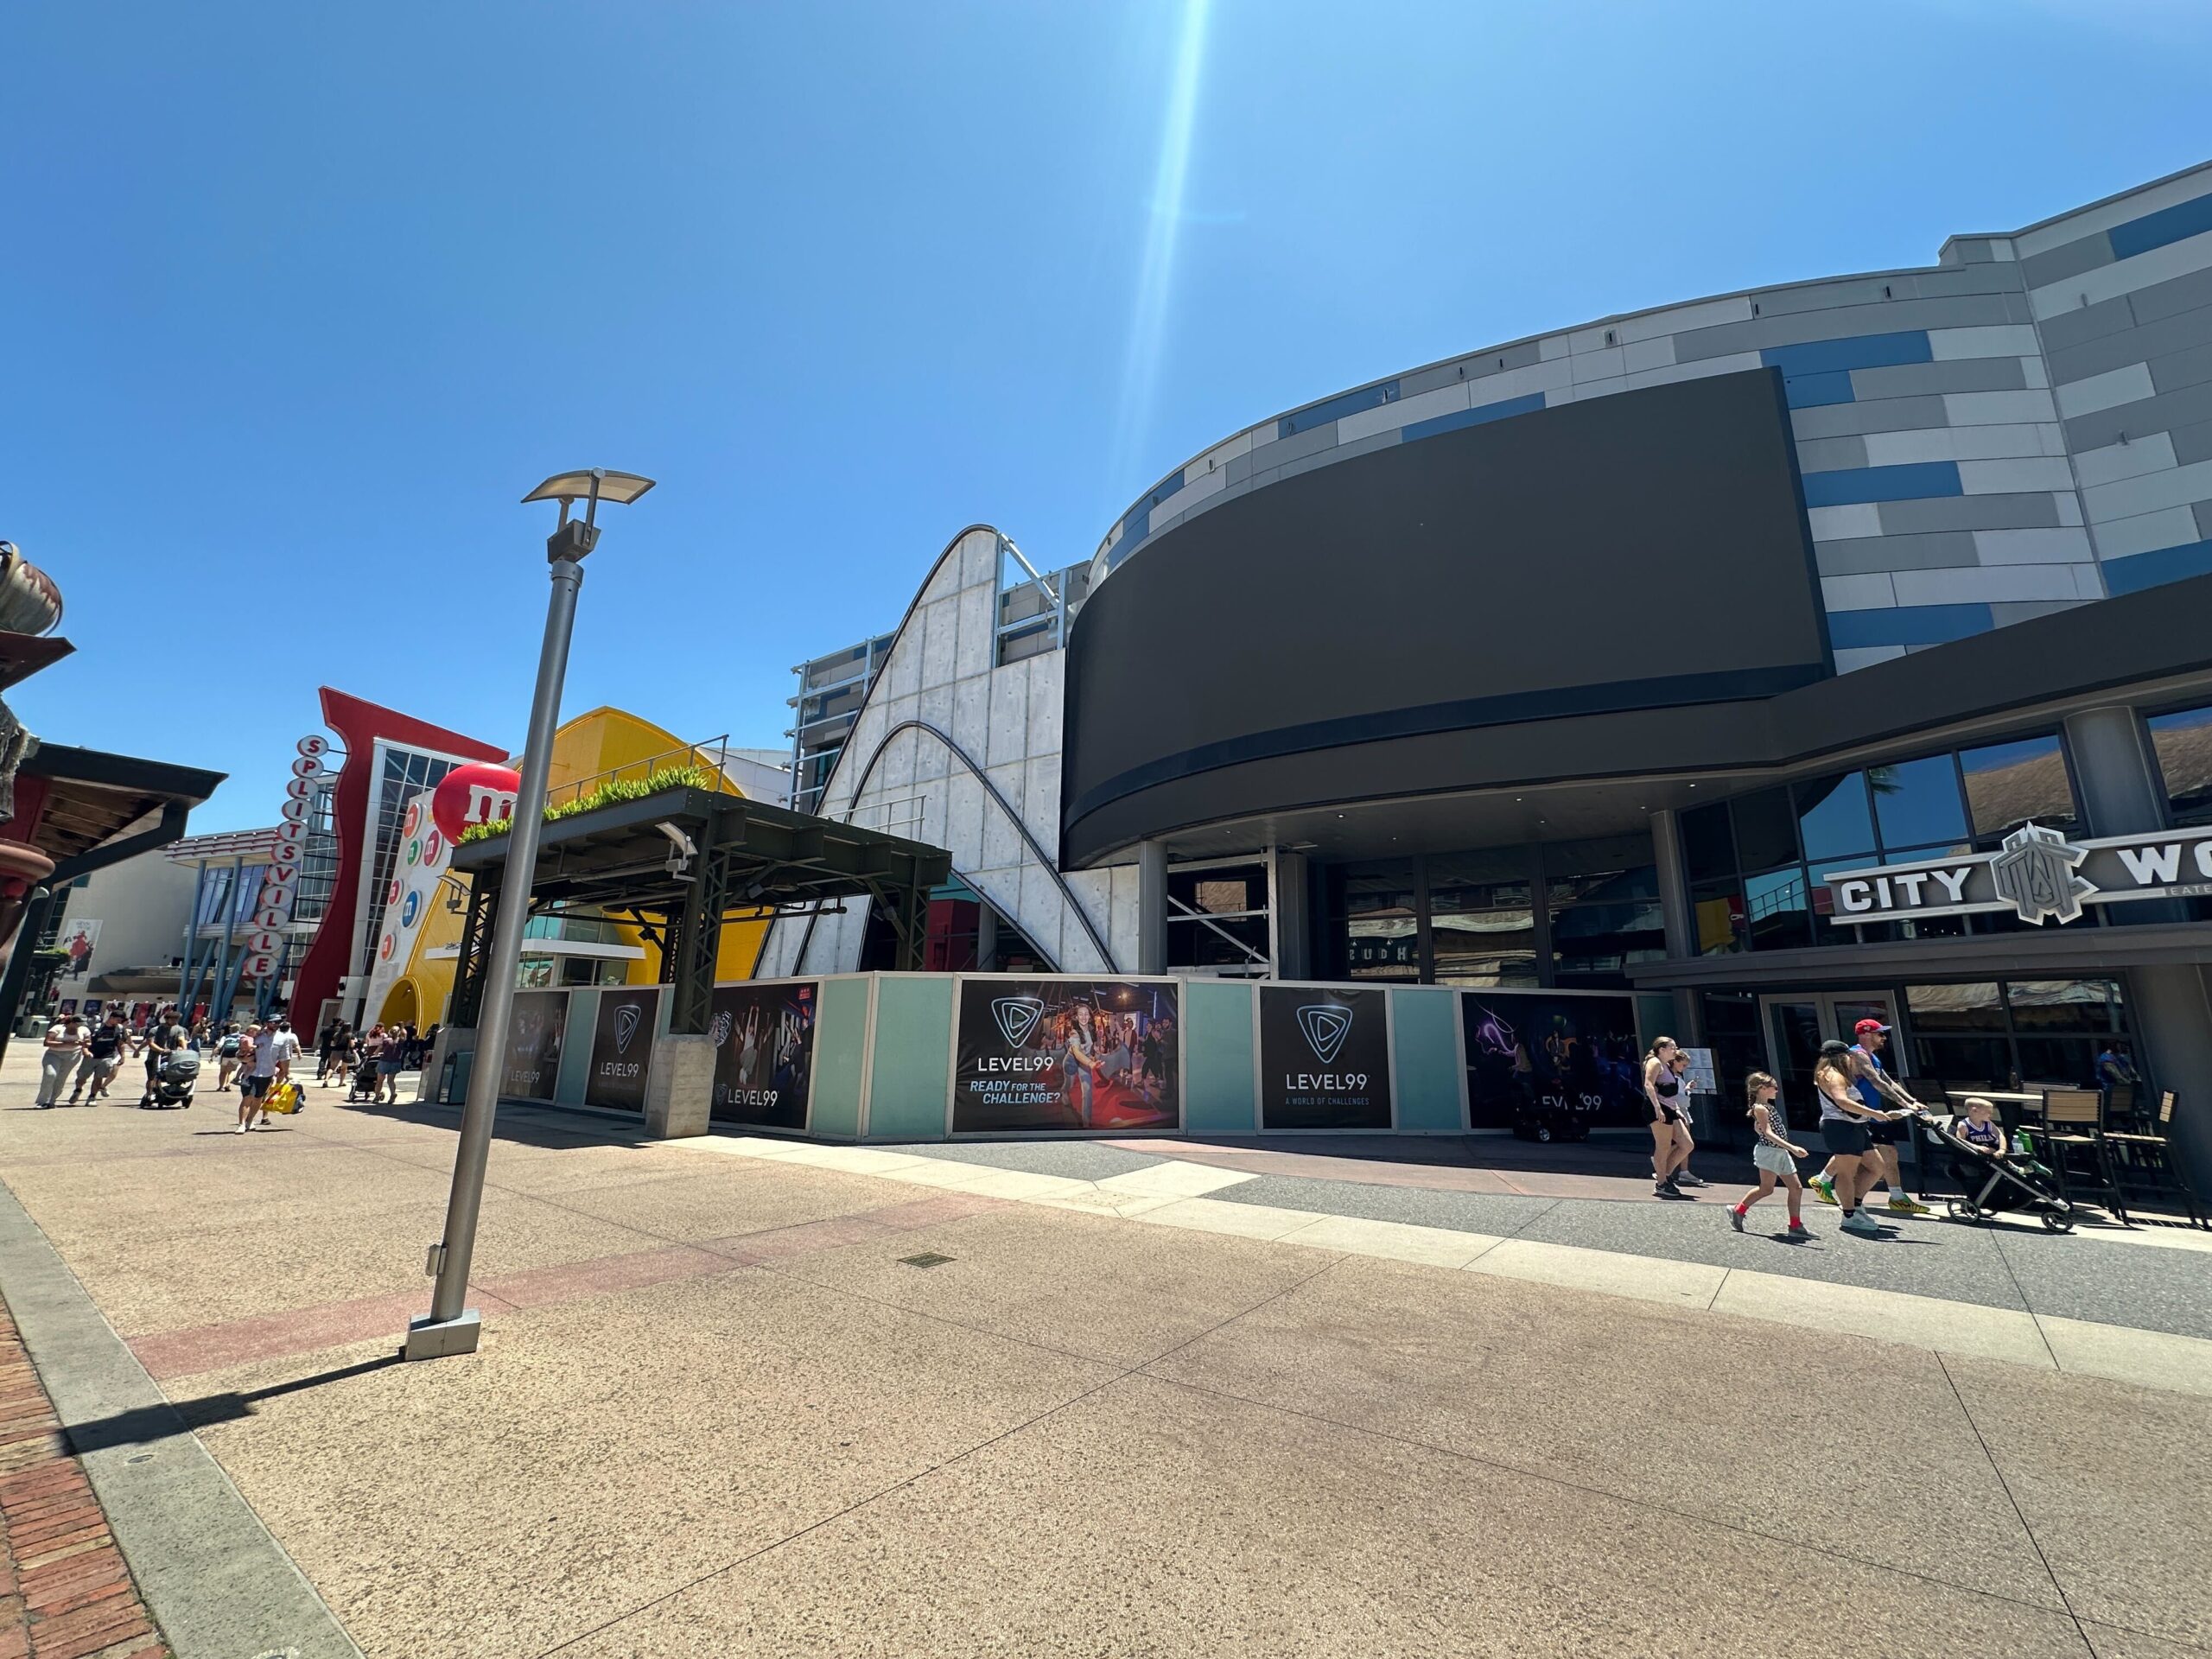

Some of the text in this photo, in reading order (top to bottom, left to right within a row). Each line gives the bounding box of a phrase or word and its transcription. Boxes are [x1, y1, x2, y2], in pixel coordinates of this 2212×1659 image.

[256, 740, 321, 972] SPLITSVILLE
[1840, 867, 1971, 912] CITY
[601, 1062, 639, 1077] LEVEL99
[978, 1057, 1053, 1071] LEVEL99
[511, 1071, 540, 1084] LEVEL99
[1287, 1073, 1367, 1090] LEVEL99
[969, 1080, 1010, 1092] READY
[728, 1089, 778, 1107] LEVEL99
[982, 1092, 1060, 1103] CHALLENGE?
